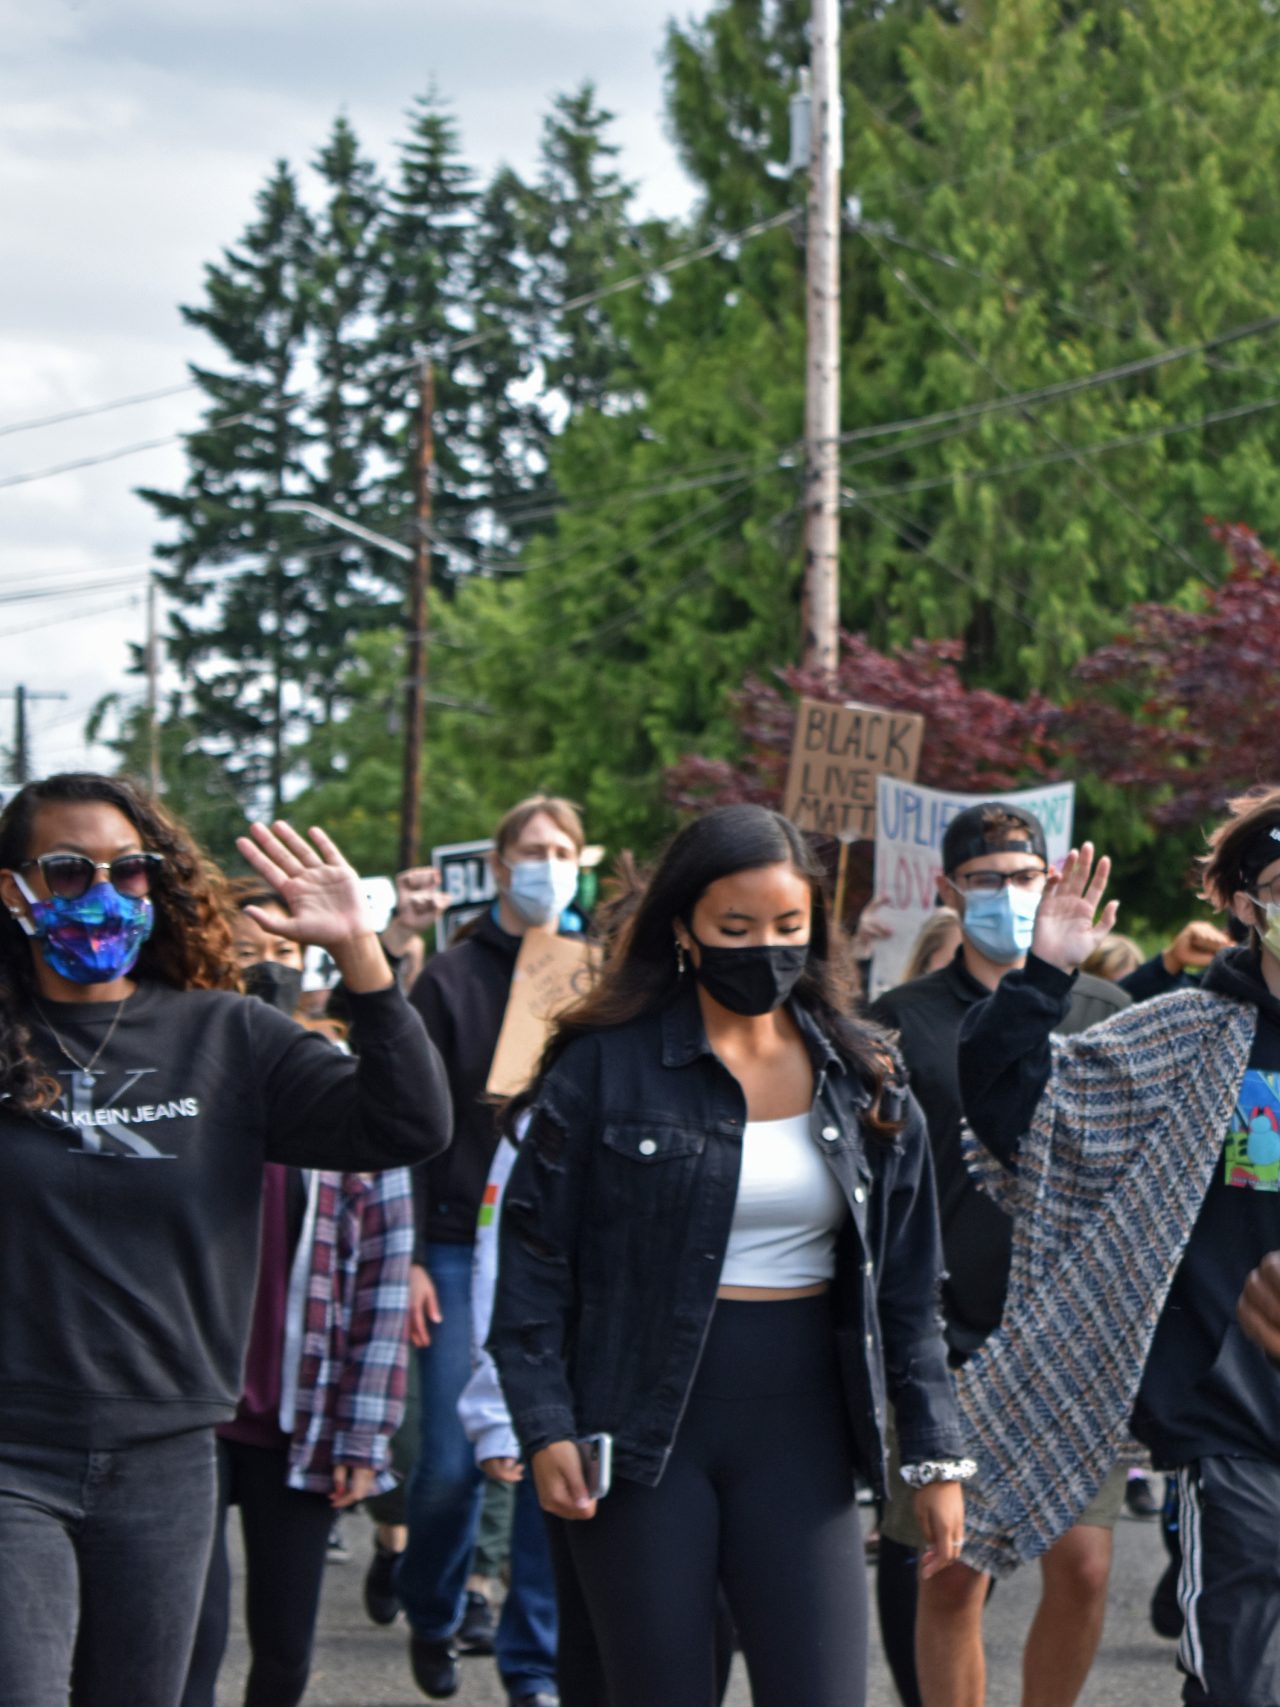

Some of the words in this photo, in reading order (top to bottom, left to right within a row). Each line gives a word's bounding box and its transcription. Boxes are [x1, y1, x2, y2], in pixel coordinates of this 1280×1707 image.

[805, 709, 913, 770] BLACK
[803, 763, 872, 800] LIVE
[881, 784, 966, 847] UPLIF
[878, 855, 943, 910] LOV
[72, 1108, 130, 1126] KLEIN
[132, 1097, 199, 1124] JEANS
